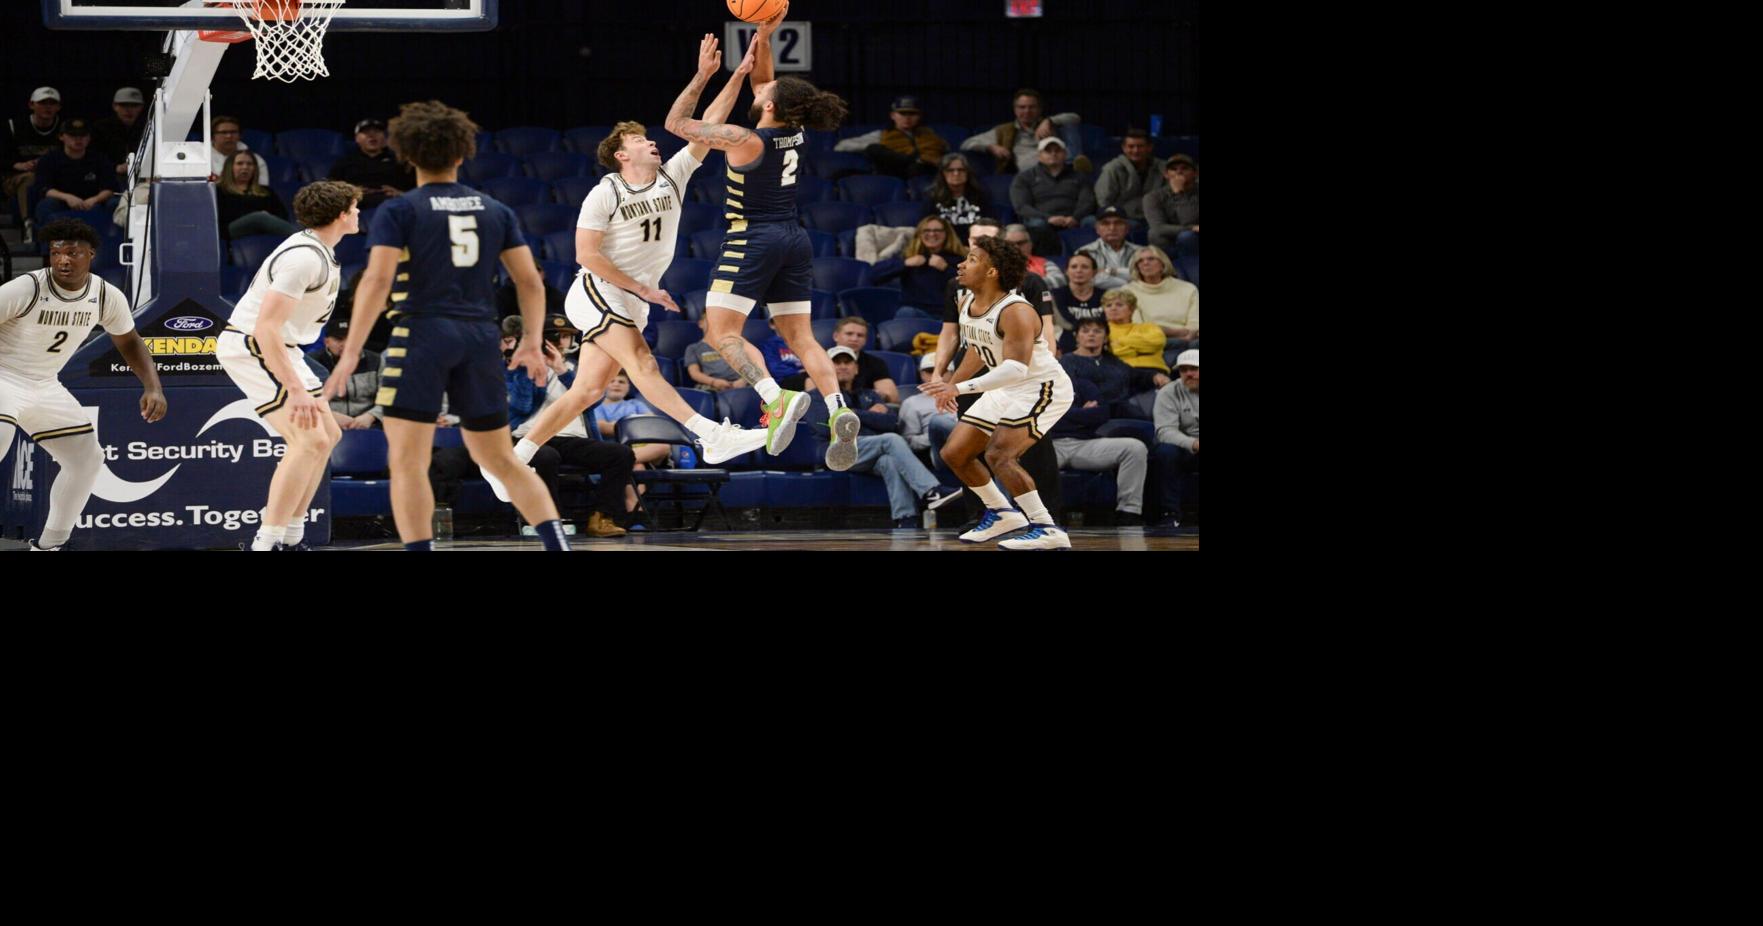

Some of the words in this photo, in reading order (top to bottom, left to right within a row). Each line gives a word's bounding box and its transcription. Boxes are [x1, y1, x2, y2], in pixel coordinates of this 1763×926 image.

[779, 28, 800, 65] 2
[781, 149, 799, 187] 2
[620, 199, 653, 221] MONTANA
[652, 194, 672, 212] STATE
[448, 214, 479, 267] 5
[640, 216, 662, 242] 11
[37, 309, 70, 325] MONTANA
[71, 311, 92, 327] STATE
[173, 318, 203, 329] Ford
[46, 331, 69, 353] 2
[12, 433, 35, 490] ACE
[127, 440, 244, 463] Security
[75, 510, 184, 528] uccess.
